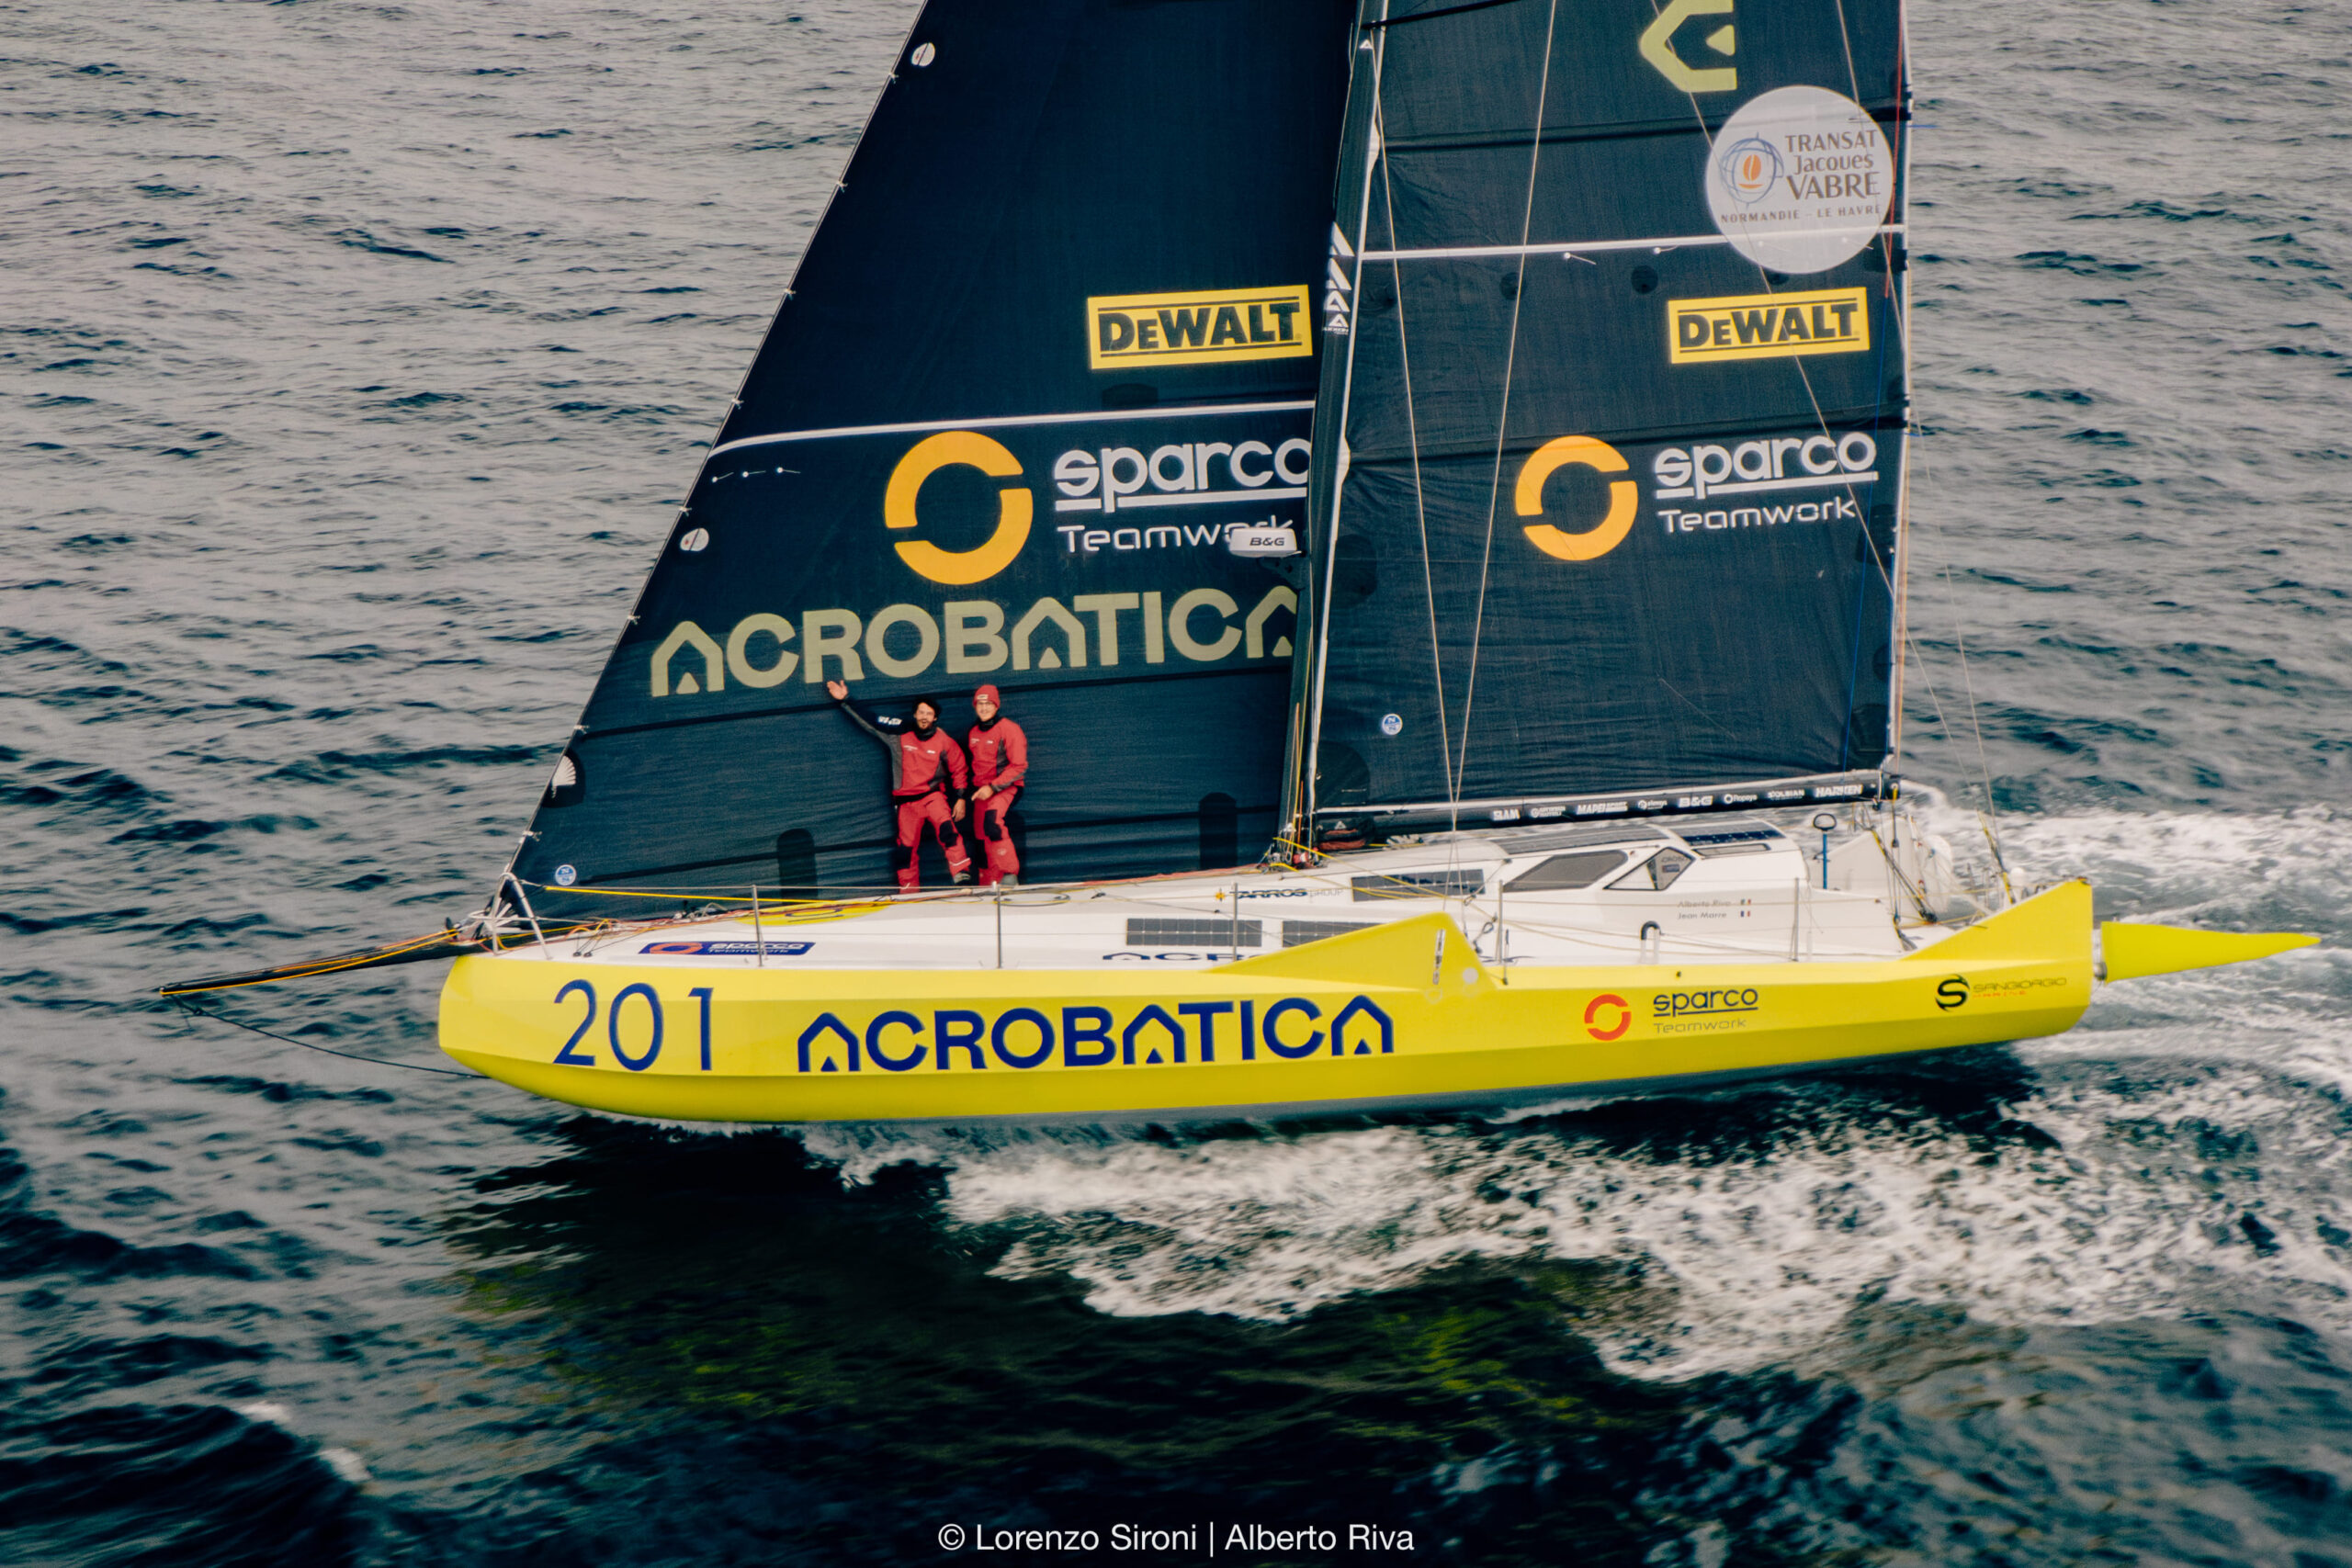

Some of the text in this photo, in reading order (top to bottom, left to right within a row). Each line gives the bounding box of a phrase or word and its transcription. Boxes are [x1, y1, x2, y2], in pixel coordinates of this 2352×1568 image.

[1784, 129, 1878, 152] TRANSAT
[1793, 153, 1874, 175] Jacques
[1786, 171, 1881, 200] VABRE
[1721, 209, 1800, 223] NORMANDIE
[1816, 207, 1833, 219] LE
[1838, 204, 1883, 217] HAVRE
[1054, 438, 1311, 513] sparco
[1654, 431, 1878, 500] sparco
[1657, 497, 1856, 534] Teamwork
[1057, 514, 1294, 552] Teamwo
[1250, 537, 1285, 547] B&G
[650, 585, 1297, 697] ACROBATICA
[1678, 795, 1713, 808] B&G
[1815, 784, 1863, 797] HARKEN
[1679, 911, 1698, 919] Jean
[1973, 977, 2067, 993] SANGIORGIO
[1653, 988, 1758, 1017] sparco
[552, 978, 713, 1072] 201
[797, 994, 1394, 1073] ACROBATICA
[1653, 1018, 1747, 1034] Teamwork
